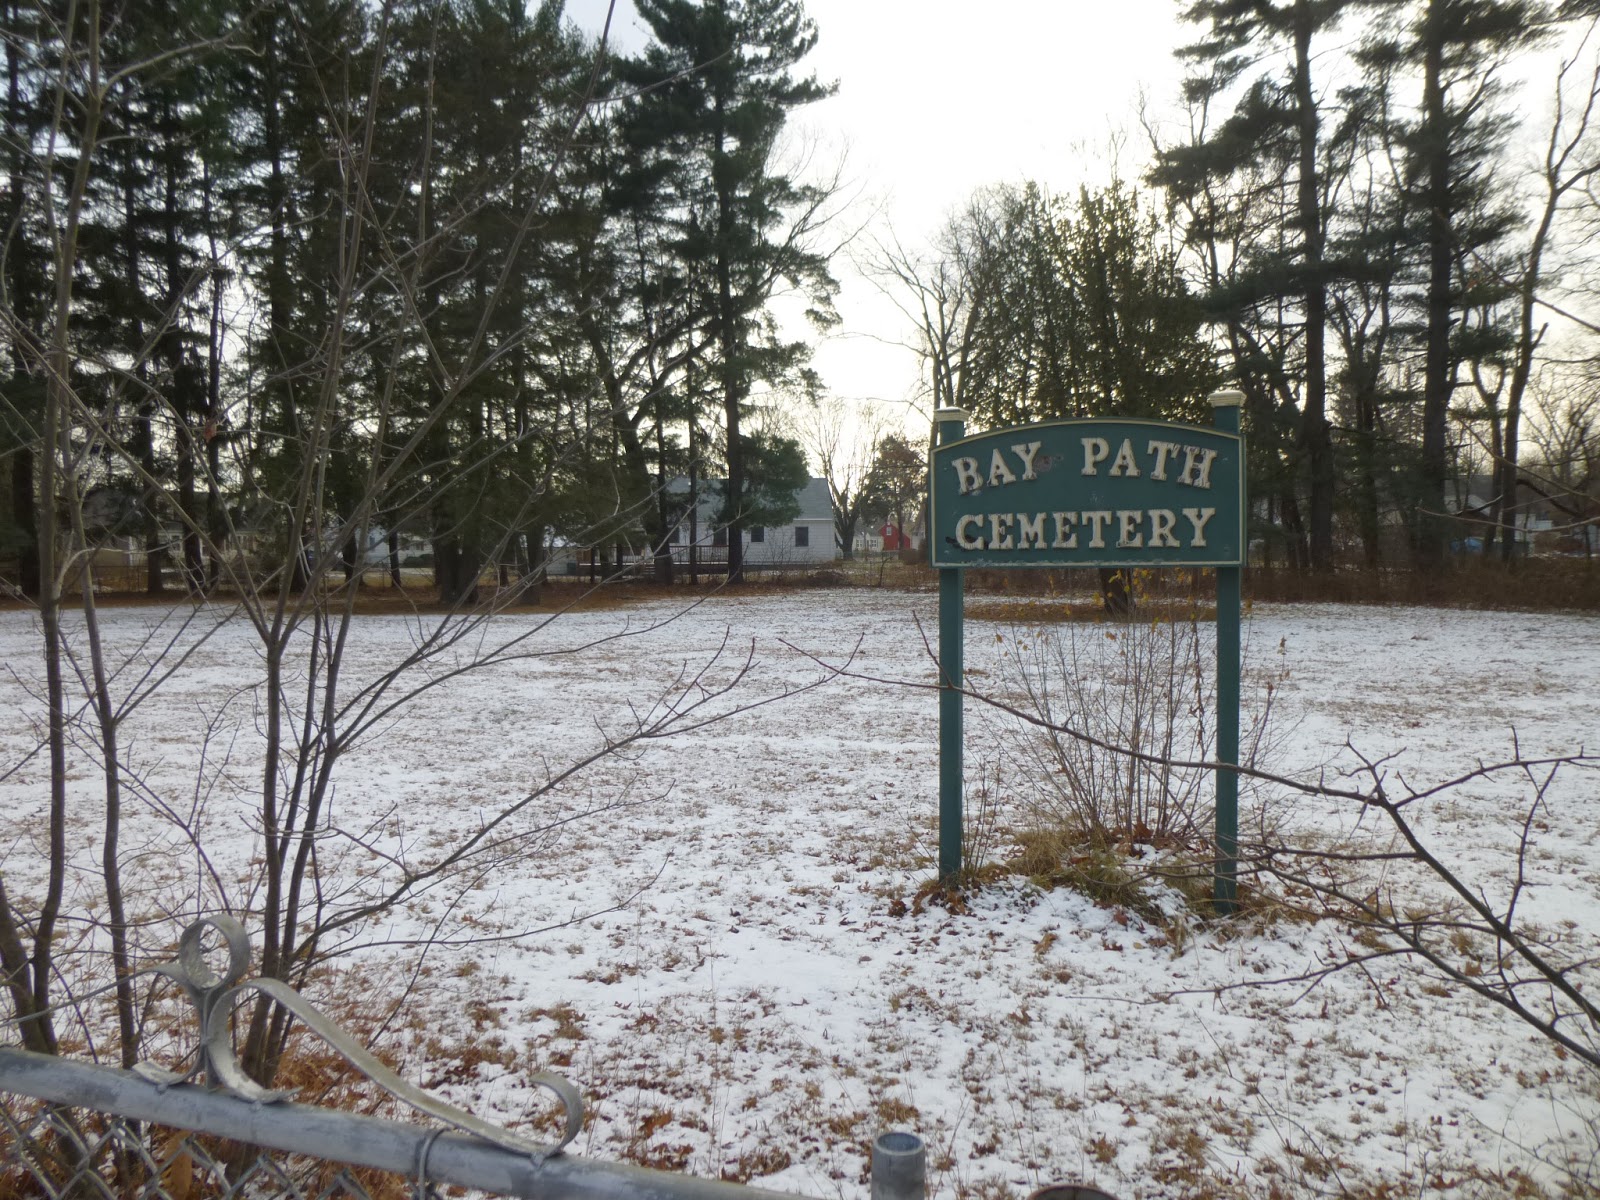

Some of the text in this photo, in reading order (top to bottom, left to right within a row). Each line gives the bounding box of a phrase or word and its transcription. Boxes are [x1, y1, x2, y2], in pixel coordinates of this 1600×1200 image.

[951, 437, 1218, 495] BAY PATH
[955, 508, 1216, 550] CEMETERY
